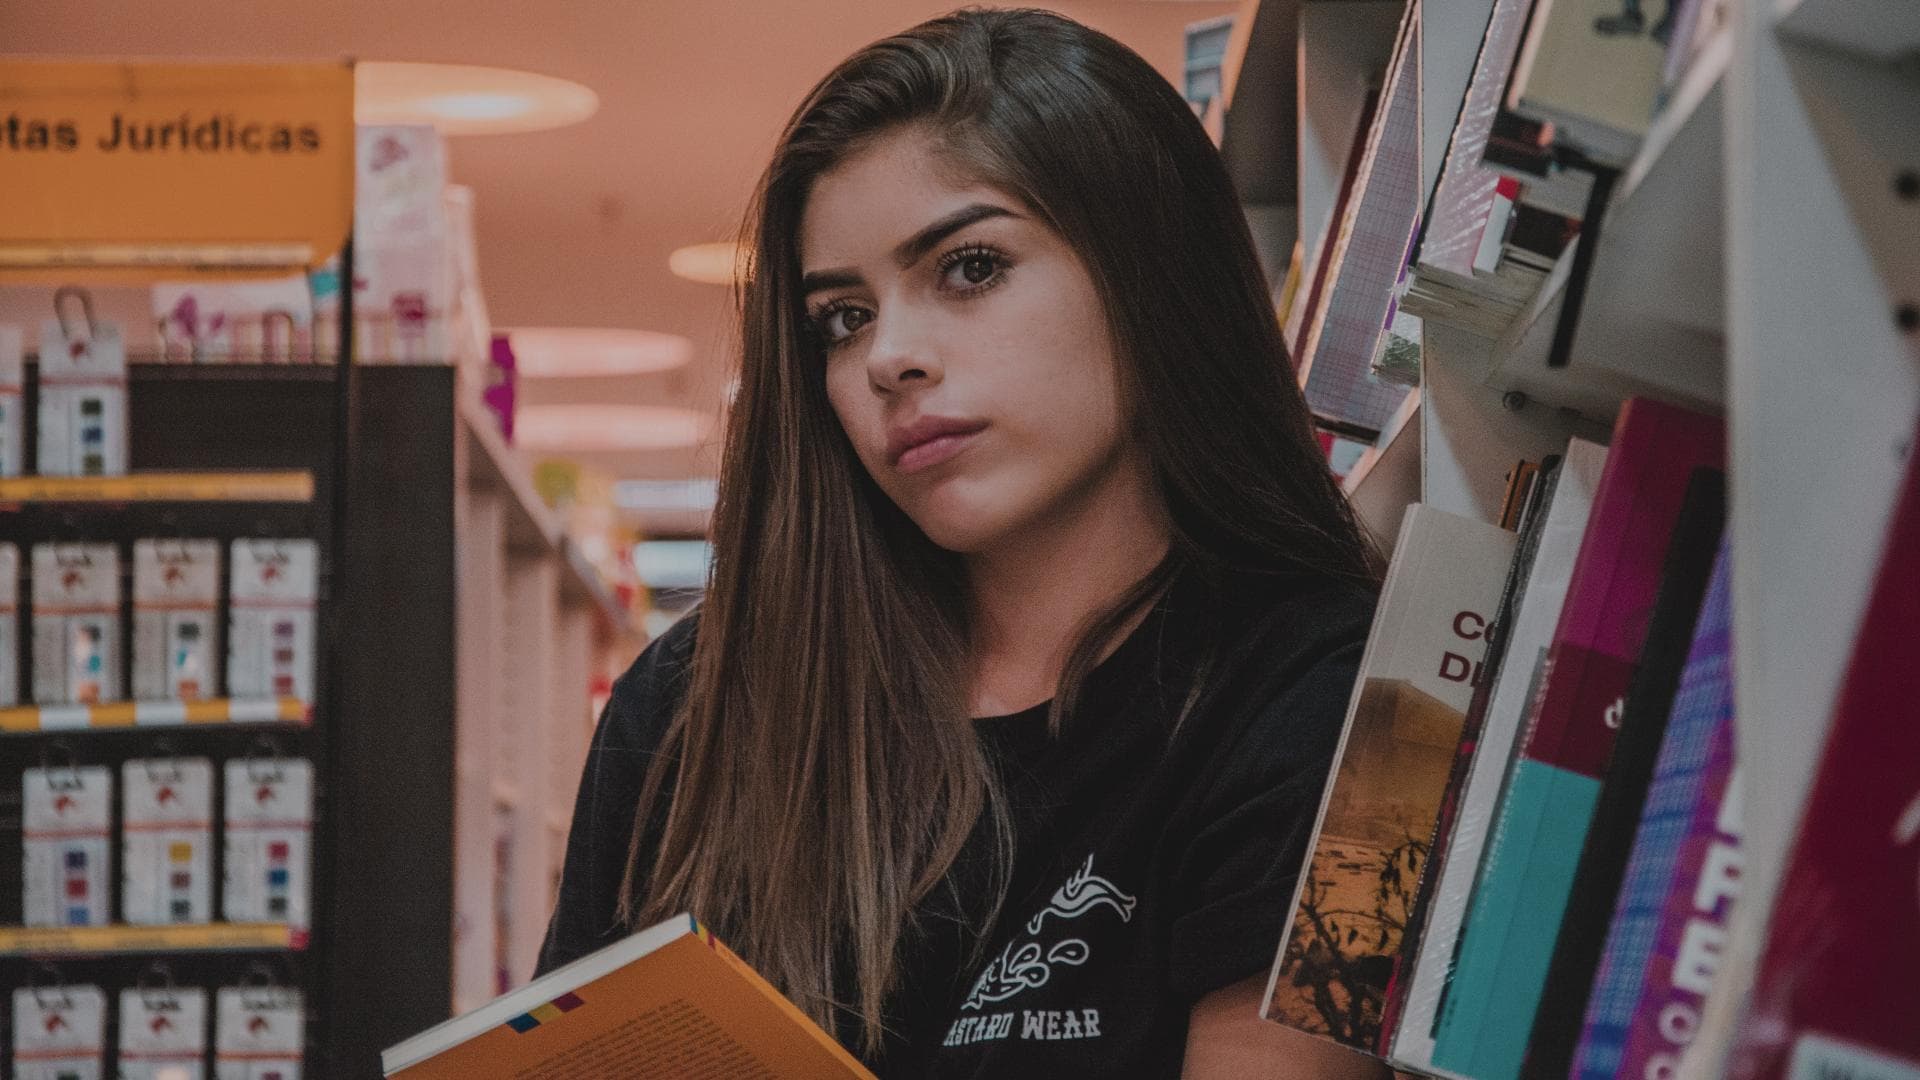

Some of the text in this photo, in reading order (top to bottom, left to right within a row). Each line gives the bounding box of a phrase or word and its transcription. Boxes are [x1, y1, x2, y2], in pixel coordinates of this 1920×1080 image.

[0, 110, 320, 152] tas Jurídicas
[1020, 1009, 1101, 1040] WEAR
